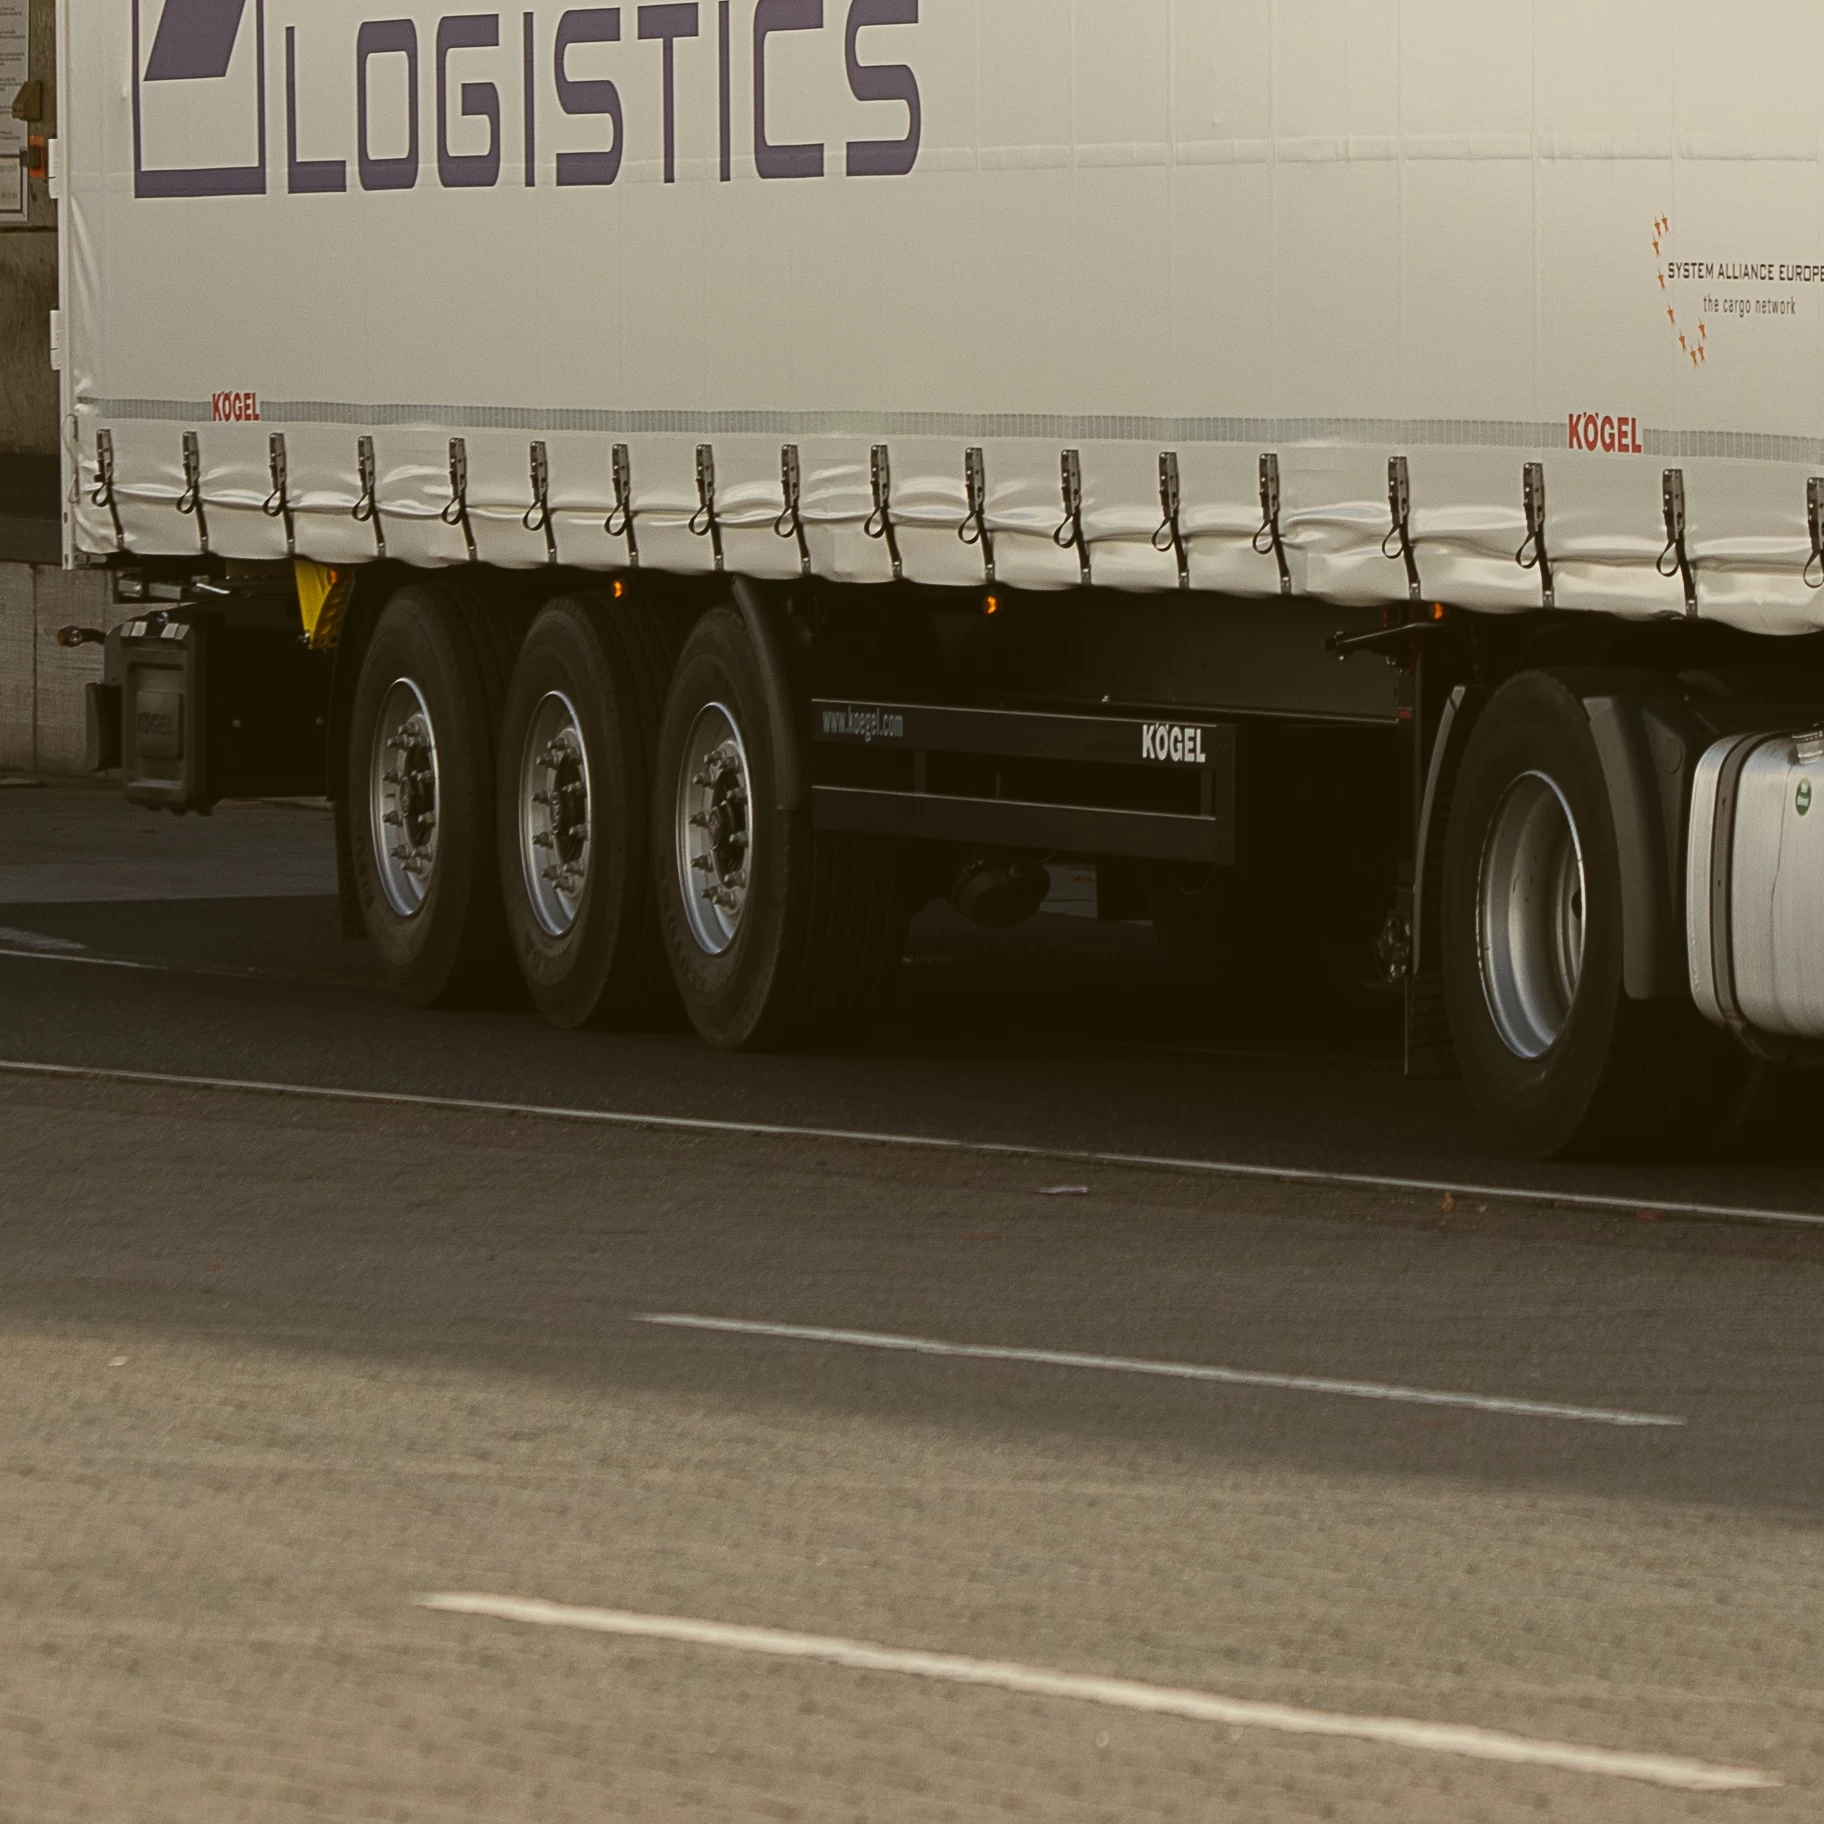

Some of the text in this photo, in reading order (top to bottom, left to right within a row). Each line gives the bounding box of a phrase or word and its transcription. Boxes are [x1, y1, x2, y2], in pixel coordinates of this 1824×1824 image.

[1668, 262, 1714, 279] SYSTEM
[1717, 263, 1775, 281] ALLIANCE
[1703, 294, 1797, 318] the cargo network
[211, 390, 261, 422] KÖGEL
[1568, 411, 1643, 454] KÖGEL
[821, 704, 904, 743] www.koegel.com
[1141, 721, 1207, 764] KÖGEL
